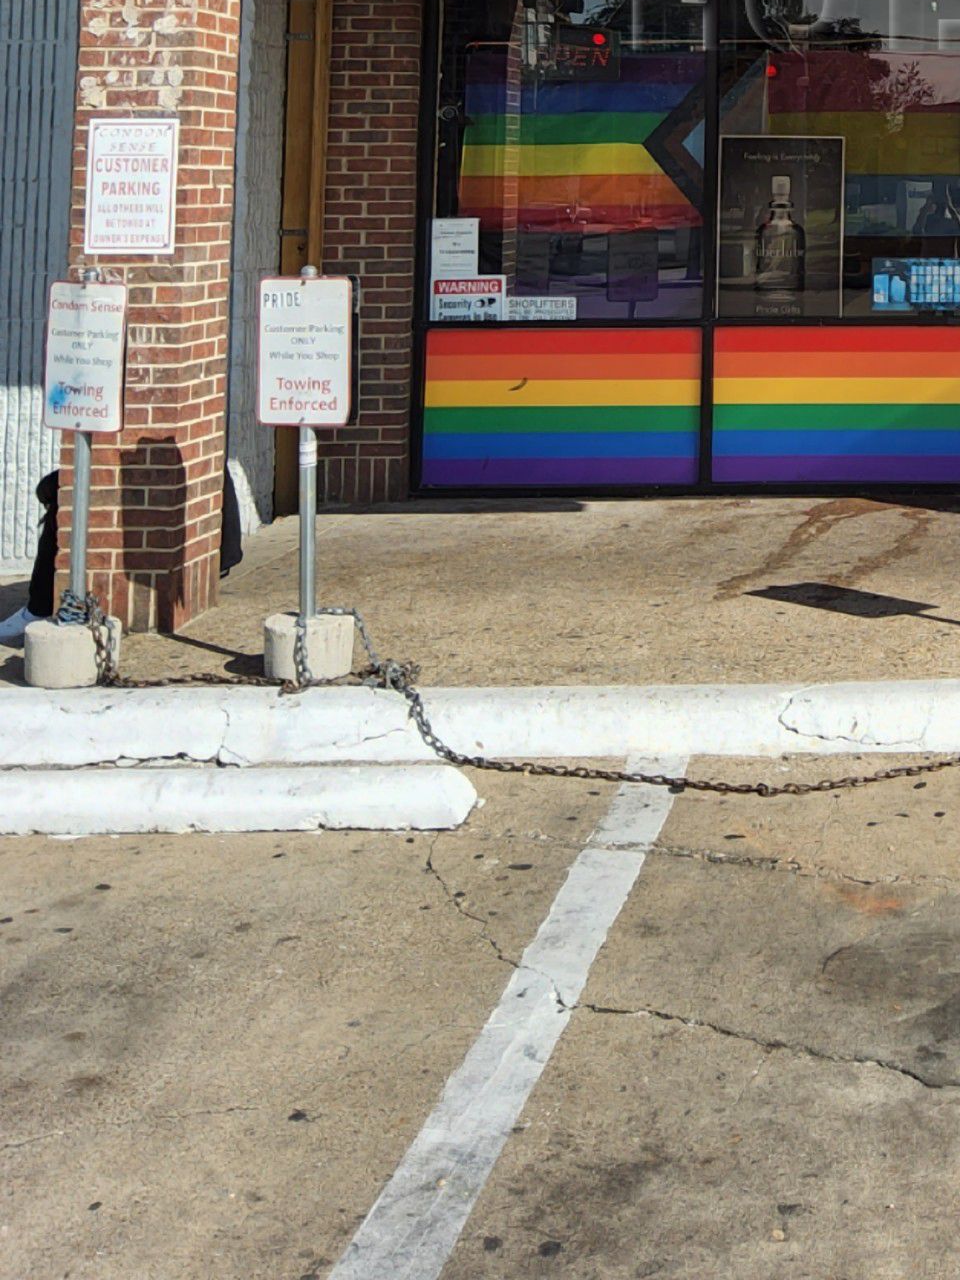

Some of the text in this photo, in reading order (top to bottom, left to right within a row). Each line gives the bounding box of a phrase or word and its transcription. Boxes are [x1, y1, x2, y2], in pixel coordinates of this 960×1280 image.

[109, 142, 157, 152] SENSE
[95, 157, 169, 173] CUSTOMER
[101, 181, 161, 196] PARKING
[97, 203, 164, 213] ALL OTHERS WILL
[117, 218, 143, 228] TOWED
[438, 281, 499, 293] WARNING
[51, 299, 123, 313] Condom Sense
[263, 291, 301, 308] PRIDE
[438, 298, 472, 311] Security
[509, 299, 576, 309] SHOPLIFTERS
[51, 328, 120, 342] Customer Parking
[264, 324, 345, 336] Customer Parking
[71, 341, 94, 351] ONLY
[290, 336, 316, 345] ONLY
[53, 354, 113, 369] While You Shop
[269, 351, 340, 362] While You Shop
[58, 381, 104, 401] Towing
[276, 376, 332, 394] Towing
[52, 401, 109, 419] Enforced
[269, 396, 338, 411] Enforced
